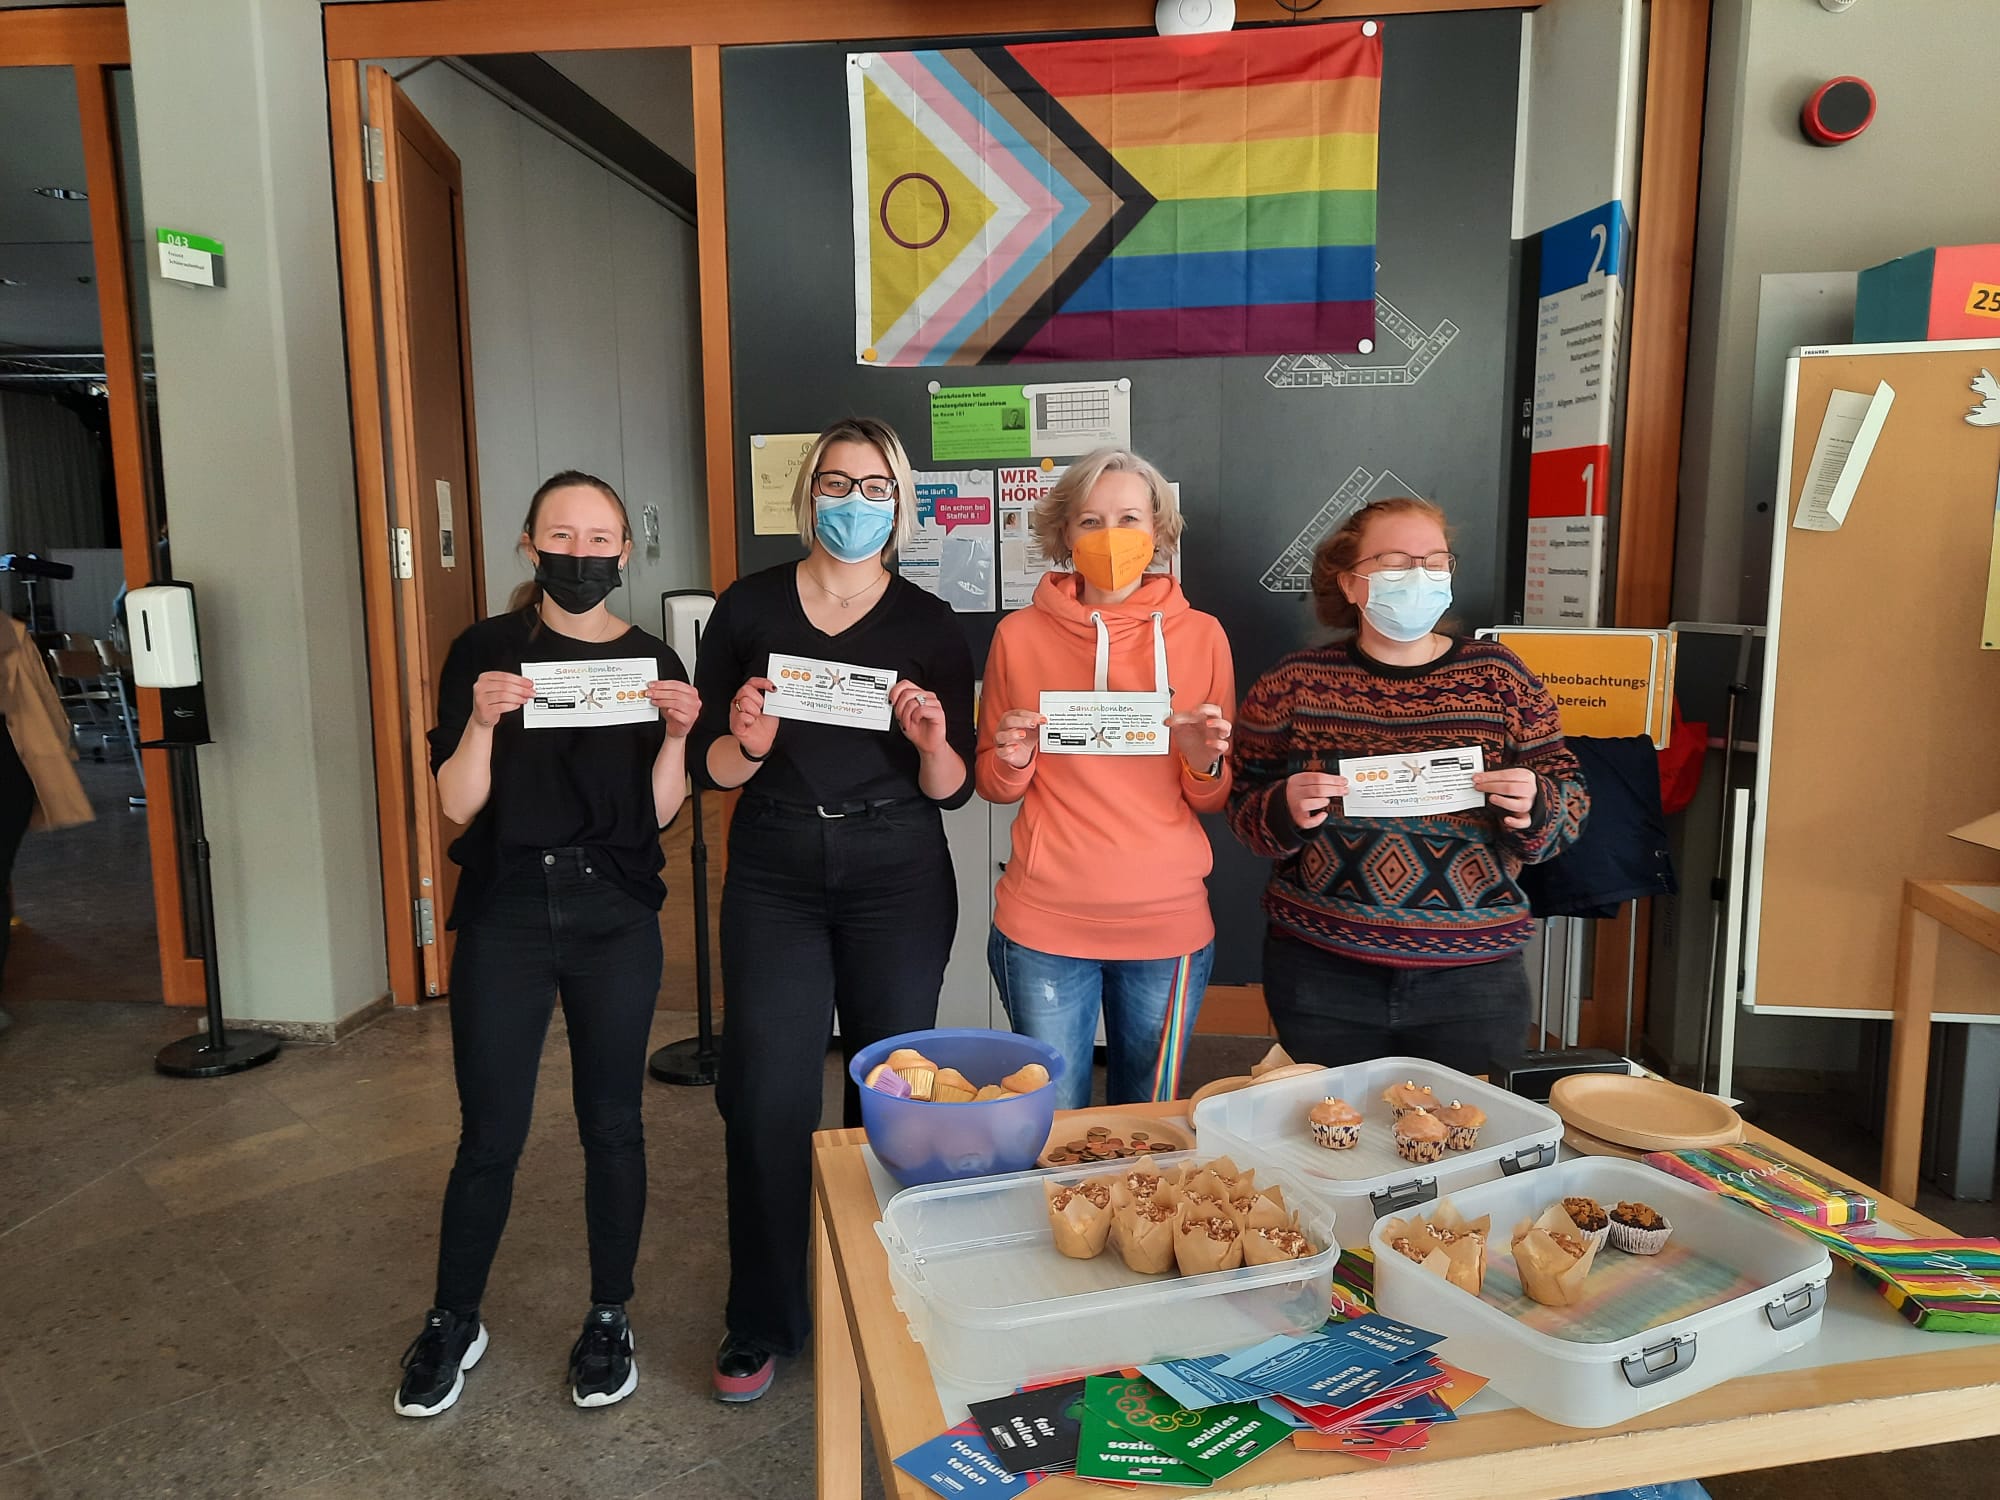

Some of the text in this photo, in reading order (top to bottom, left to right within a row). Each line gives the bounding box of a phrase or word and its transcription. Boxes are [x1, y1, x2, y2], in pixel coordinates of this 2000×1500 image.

[167, 234, 189, 248] 043
[1587, 223, 1607, 284] 2
[1000, 469, 1038, 484] WIR
[1581, 463, 1594, 517] 1
[554, 665, 622, 675] Samenbomben
[1535, 673, 1648, 690] chbeobachtungs-
[799, 700, 864, 715] Samenbomben
[1068, 703, 1134, 712] Samenbomben
[1556, 694, 1607, 708] bereich
[1346, 1330, 1398, 1353] Wirkung
[1360, 1324, 1416, 1346] entfalten
[1306, 1365, 1364, 1391] Wirkung
[1326, 1369, 1382, 1398] entfalten
[1010, 1416, 1040, 1449] teilen
[1032, 1416, 1056, 1438] fair
[1186, 1414, 1240, 1449] soziales
[1198, 1420, 1262, 1460] vernetzen
[946, 1456, 988, 1487] teilen
[950, 1440, 1017, 1484] Hoffnung
